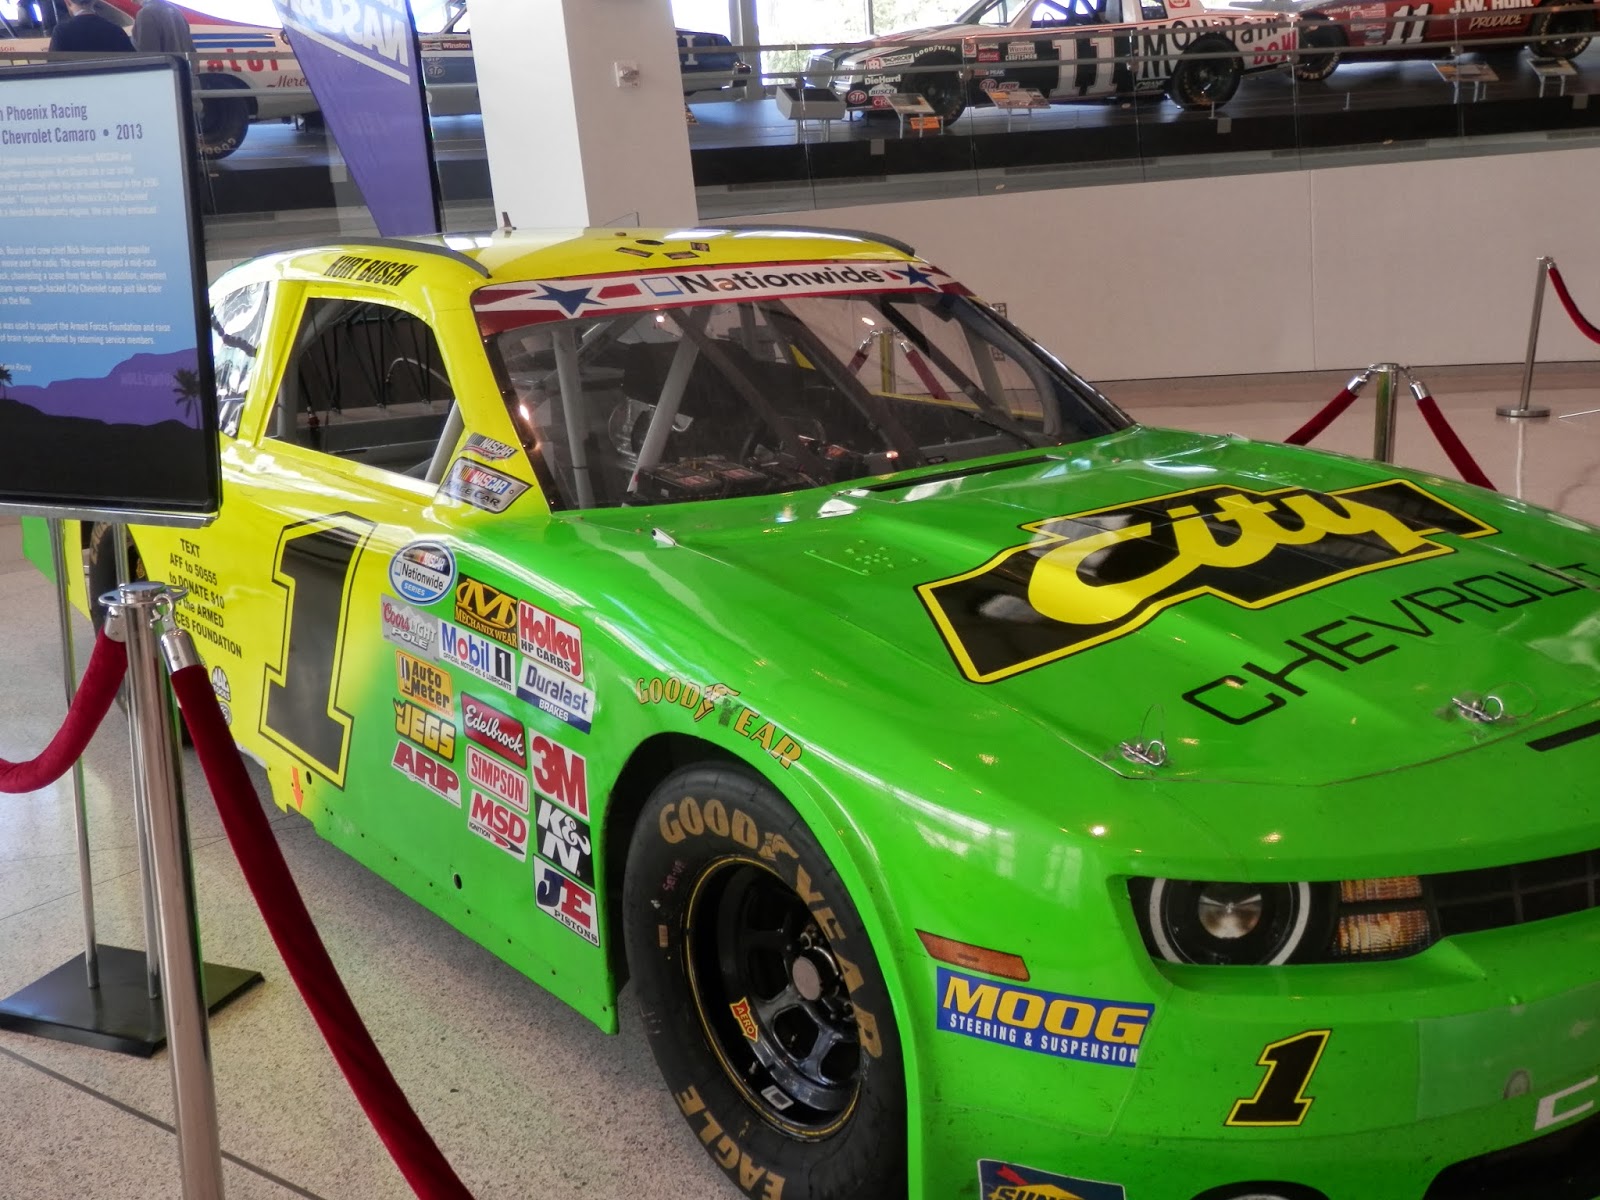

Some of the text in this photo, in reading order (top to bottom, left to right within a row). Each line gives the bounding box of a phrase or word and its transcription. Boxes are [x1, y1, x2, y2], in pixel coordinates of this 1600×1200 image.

[1387, 3, 1432, 46] 11
[1469, 14, 1523, 31] PRODUCE
[915, 44, 957, 58] GOODYEAR
[1050, 31, 1117, 97] 11
[428, 66, 443, 75] STP
[864, 74, 901, 85] DieHard
[6, 104, 48, 121] Phoenix
[50, 103, 88, 121] Racing
[850, 92, 864, 101] STP
[2, 123, 143, 145] Chevrolet Camaro 2013
[323, 255, 419, 286] KURT BUSCH
[674, 265, 885, 295] Nationwide
[36, 322, 58, 332] support
[59, 322, 69, 330] the
[70, 322, 89, 331] Armed
[89, 322, 109, 331] Forces
[109, 322, 142, 331] Foundation
[105, 336, 126, 344] service
[480, 438, 516, 458] NASCAR
[469, 469, 509, 496] NASCAR
[474, 490, 500, 507] CAR
[179, 537, 201, 559] TEXT
[423, 551, 446, 572] NASCAR
[1027, 490, 1425, 626] City
[169, 552, 218, 587] AFF to 50555
[401, 563, 444, 591] Nationwide
[169, 571, 225, 610] to DONATE $10
[403, 582, 426, 597] SERIES
[182, 597, 225, 629] the ARMED
[382, 601, 438, 644] Coors LIGHT
[455, 606, 518, 649] MECHANIX WEAR
[175, 611, 242, 659] CES FOUNDATION
[258, 510, 379, 791] 1
[391, 626, 429, 651] POLE
[441, 622, 490, 673] Mobil
[520, 603, 582, 677] Holley
[443, 652, 460, 665] OFFICIAL
[460, 661, 475, 672] MOTOR
[485, 673, 512, 692] LUBRICANTS
[520, 639, 571, 673] HP CARBS
[412, 660, 442, 689] Auto
[525, 664, 588, 714] Duralast
[411, 676, 450, 708] Meter
[538, 698, 569, 722] BRAKES
[635, 677, 803, 770] GOODYEAR
[392, 697, 457, 764] JEGS
[464, 704, 525, 757] Edelbrock
[393, 741, 460, 795] ARP
[471, 751, 524, 804] SIMPSON
[532, 735, 588, 818] 3M
[468, 821, 491, 839] IGNITION
[471, 793, 527, 844] MSD
[536, 868, 591, 929] JE
[553, 909, 598, 944] PISTONS
[736, 1007, 755, 1034] AERO
[943, 976, 1149, 1045] MOOG
[950, 1013, 1139, 1064] STEERING & SUSPENSION
[1222, 1028, 1333, 1127] 1
[674, 1084, 787, 1200] EAGLE
